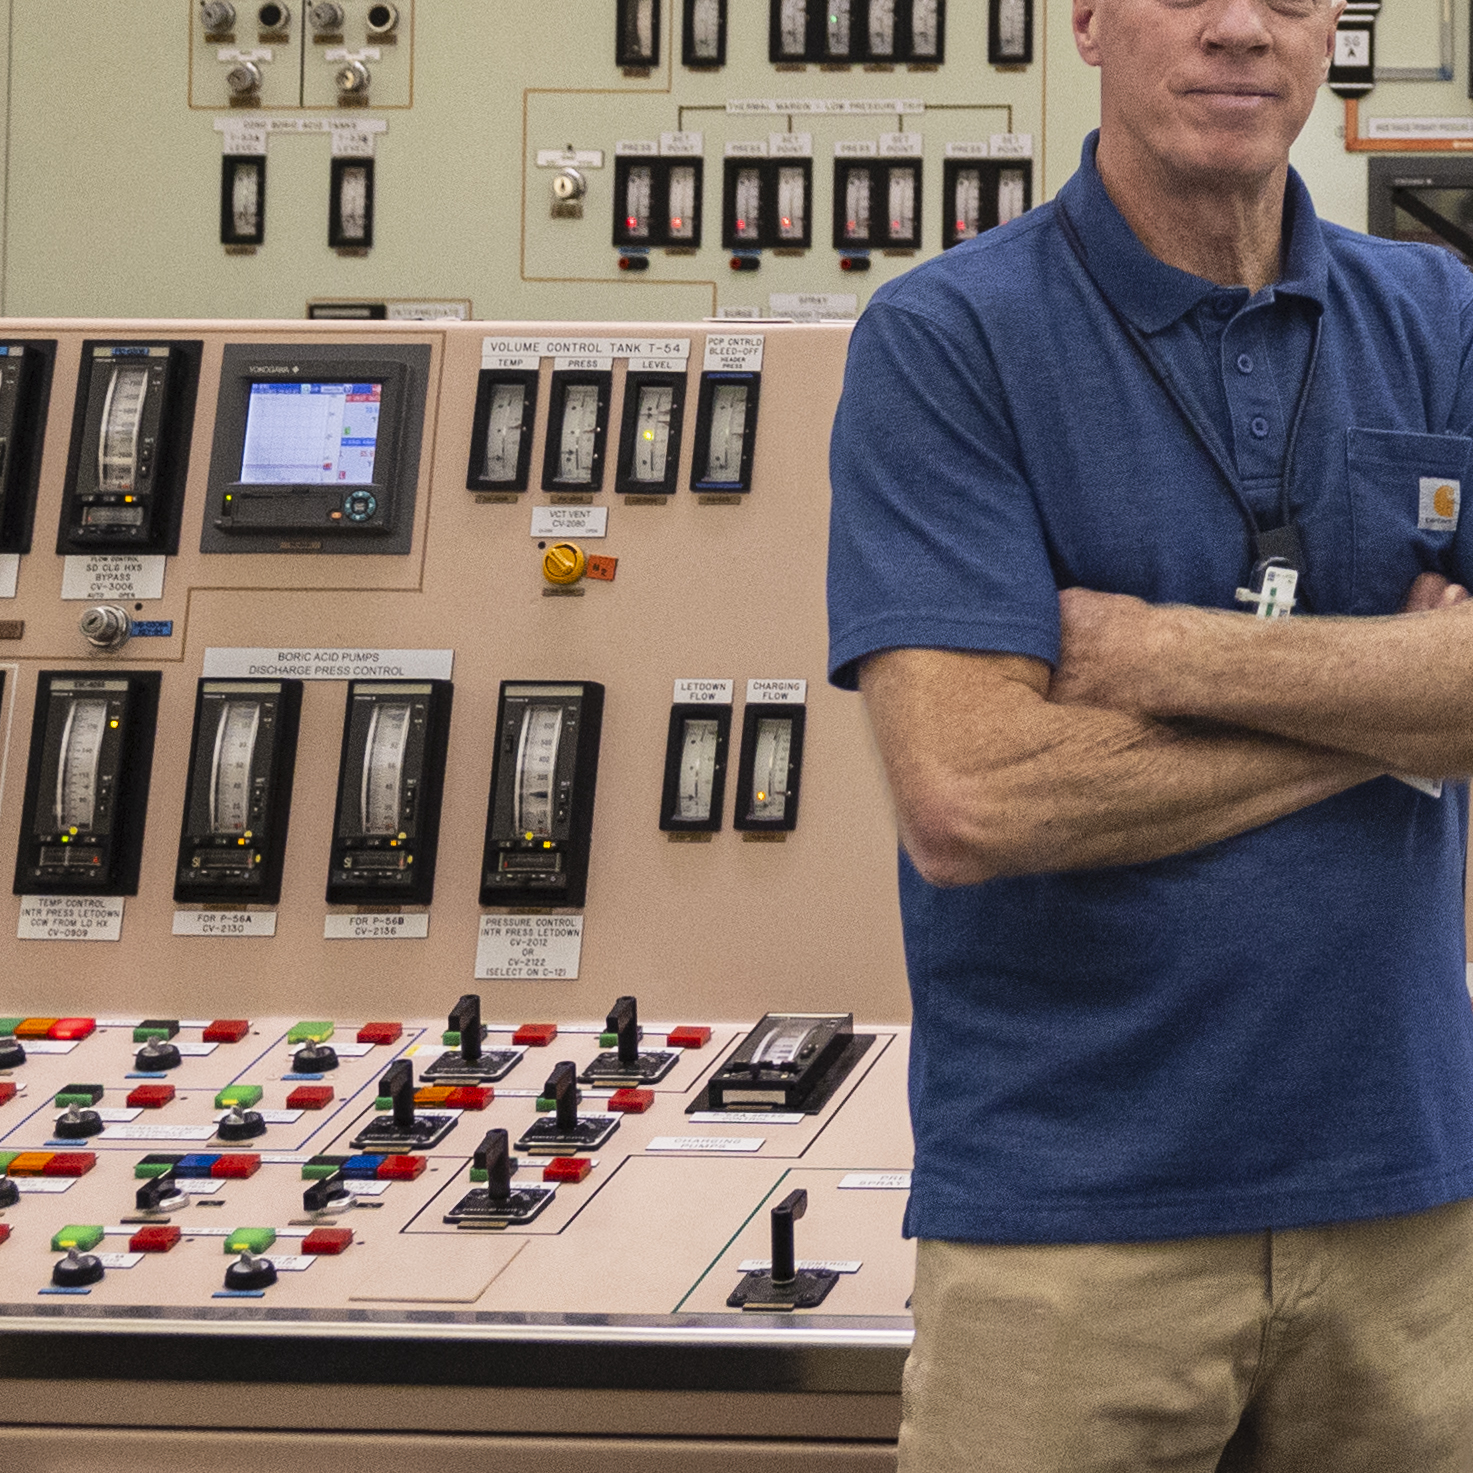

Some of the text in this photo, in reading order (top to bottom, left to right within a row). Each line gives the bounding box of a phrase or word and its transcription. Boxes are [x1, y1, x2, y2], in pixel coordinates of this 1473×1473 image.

[1343, 35, 1361, 47] SG
[491, 343, 680, 353] VOLUME CONTROL TANK T-54
[709, 347, 759, 355] BLEED-OFF
[568, 360, 597, 368] PRESS
[549, 510, 590, 518] VCT VENT
[552, 519, 585, 528] CV-2080
[278, 653, 379, 662] BORIC ACID PUMPS
[249, 666, 404, 676] DISCHARGE PRESS CONTROL
[681, 683, 725, 691] LETDOWN
[753, 683, 800, 691] CHARGING
[762, 692, 788, 700] FLOW
[68, 899, 105, 907] CONTROL
[198, 915, 252, 923] FOR P-56A
[486, 918, 576, 927] PRESSURE CONTROL
[48, 929, 88, 937] CV-0909
[522, 948, 534, 956] OR
[508, 958, 545, 966] CV-2122
